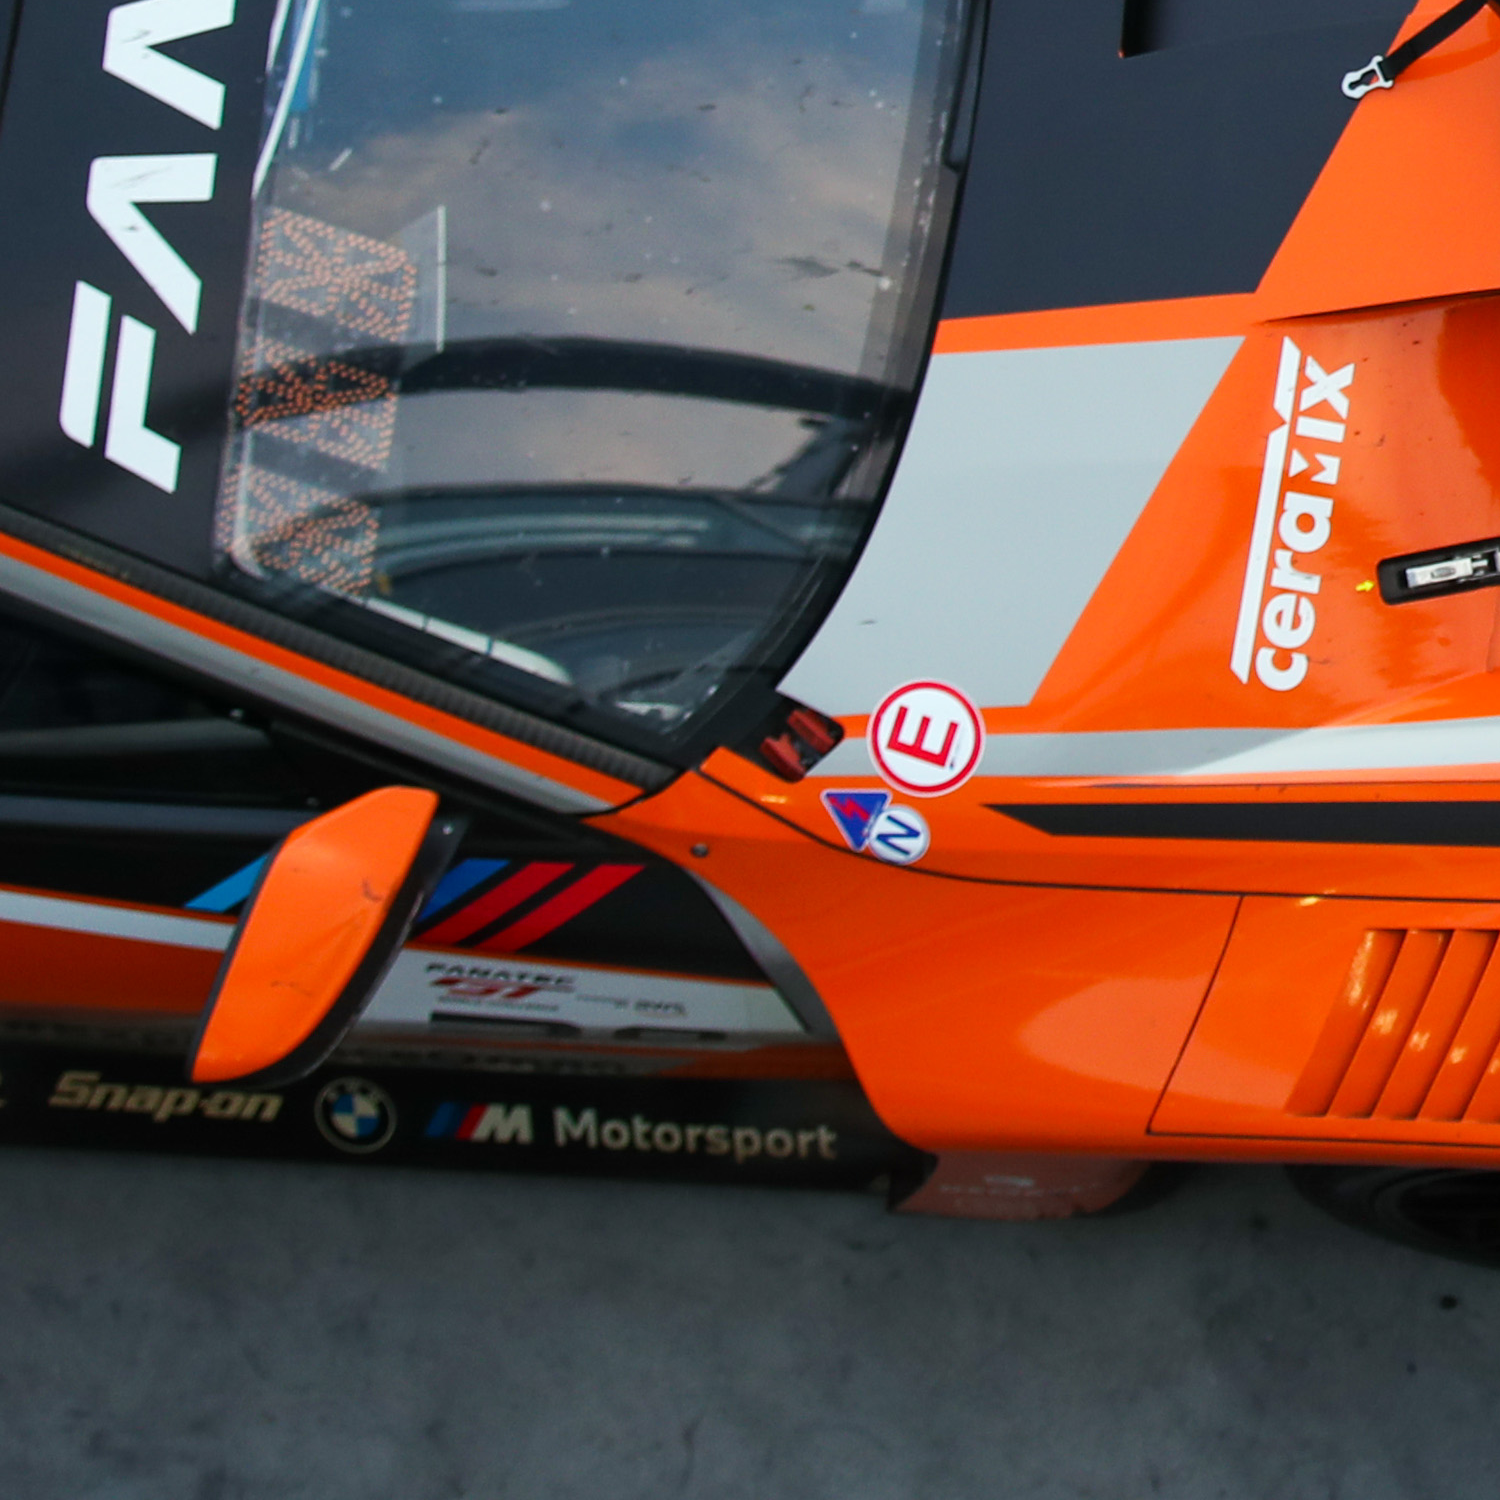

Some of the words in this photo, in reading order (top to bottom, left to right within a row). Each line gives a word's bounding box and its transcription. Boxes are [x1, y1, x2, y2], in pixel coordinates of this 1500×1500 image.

[886, 706, 959, 769] E
[875, 814, 921, 856] N
[48, 1070, 282, 1123] Snap-on
[552, 1107, 839, 1165] Motorsport
